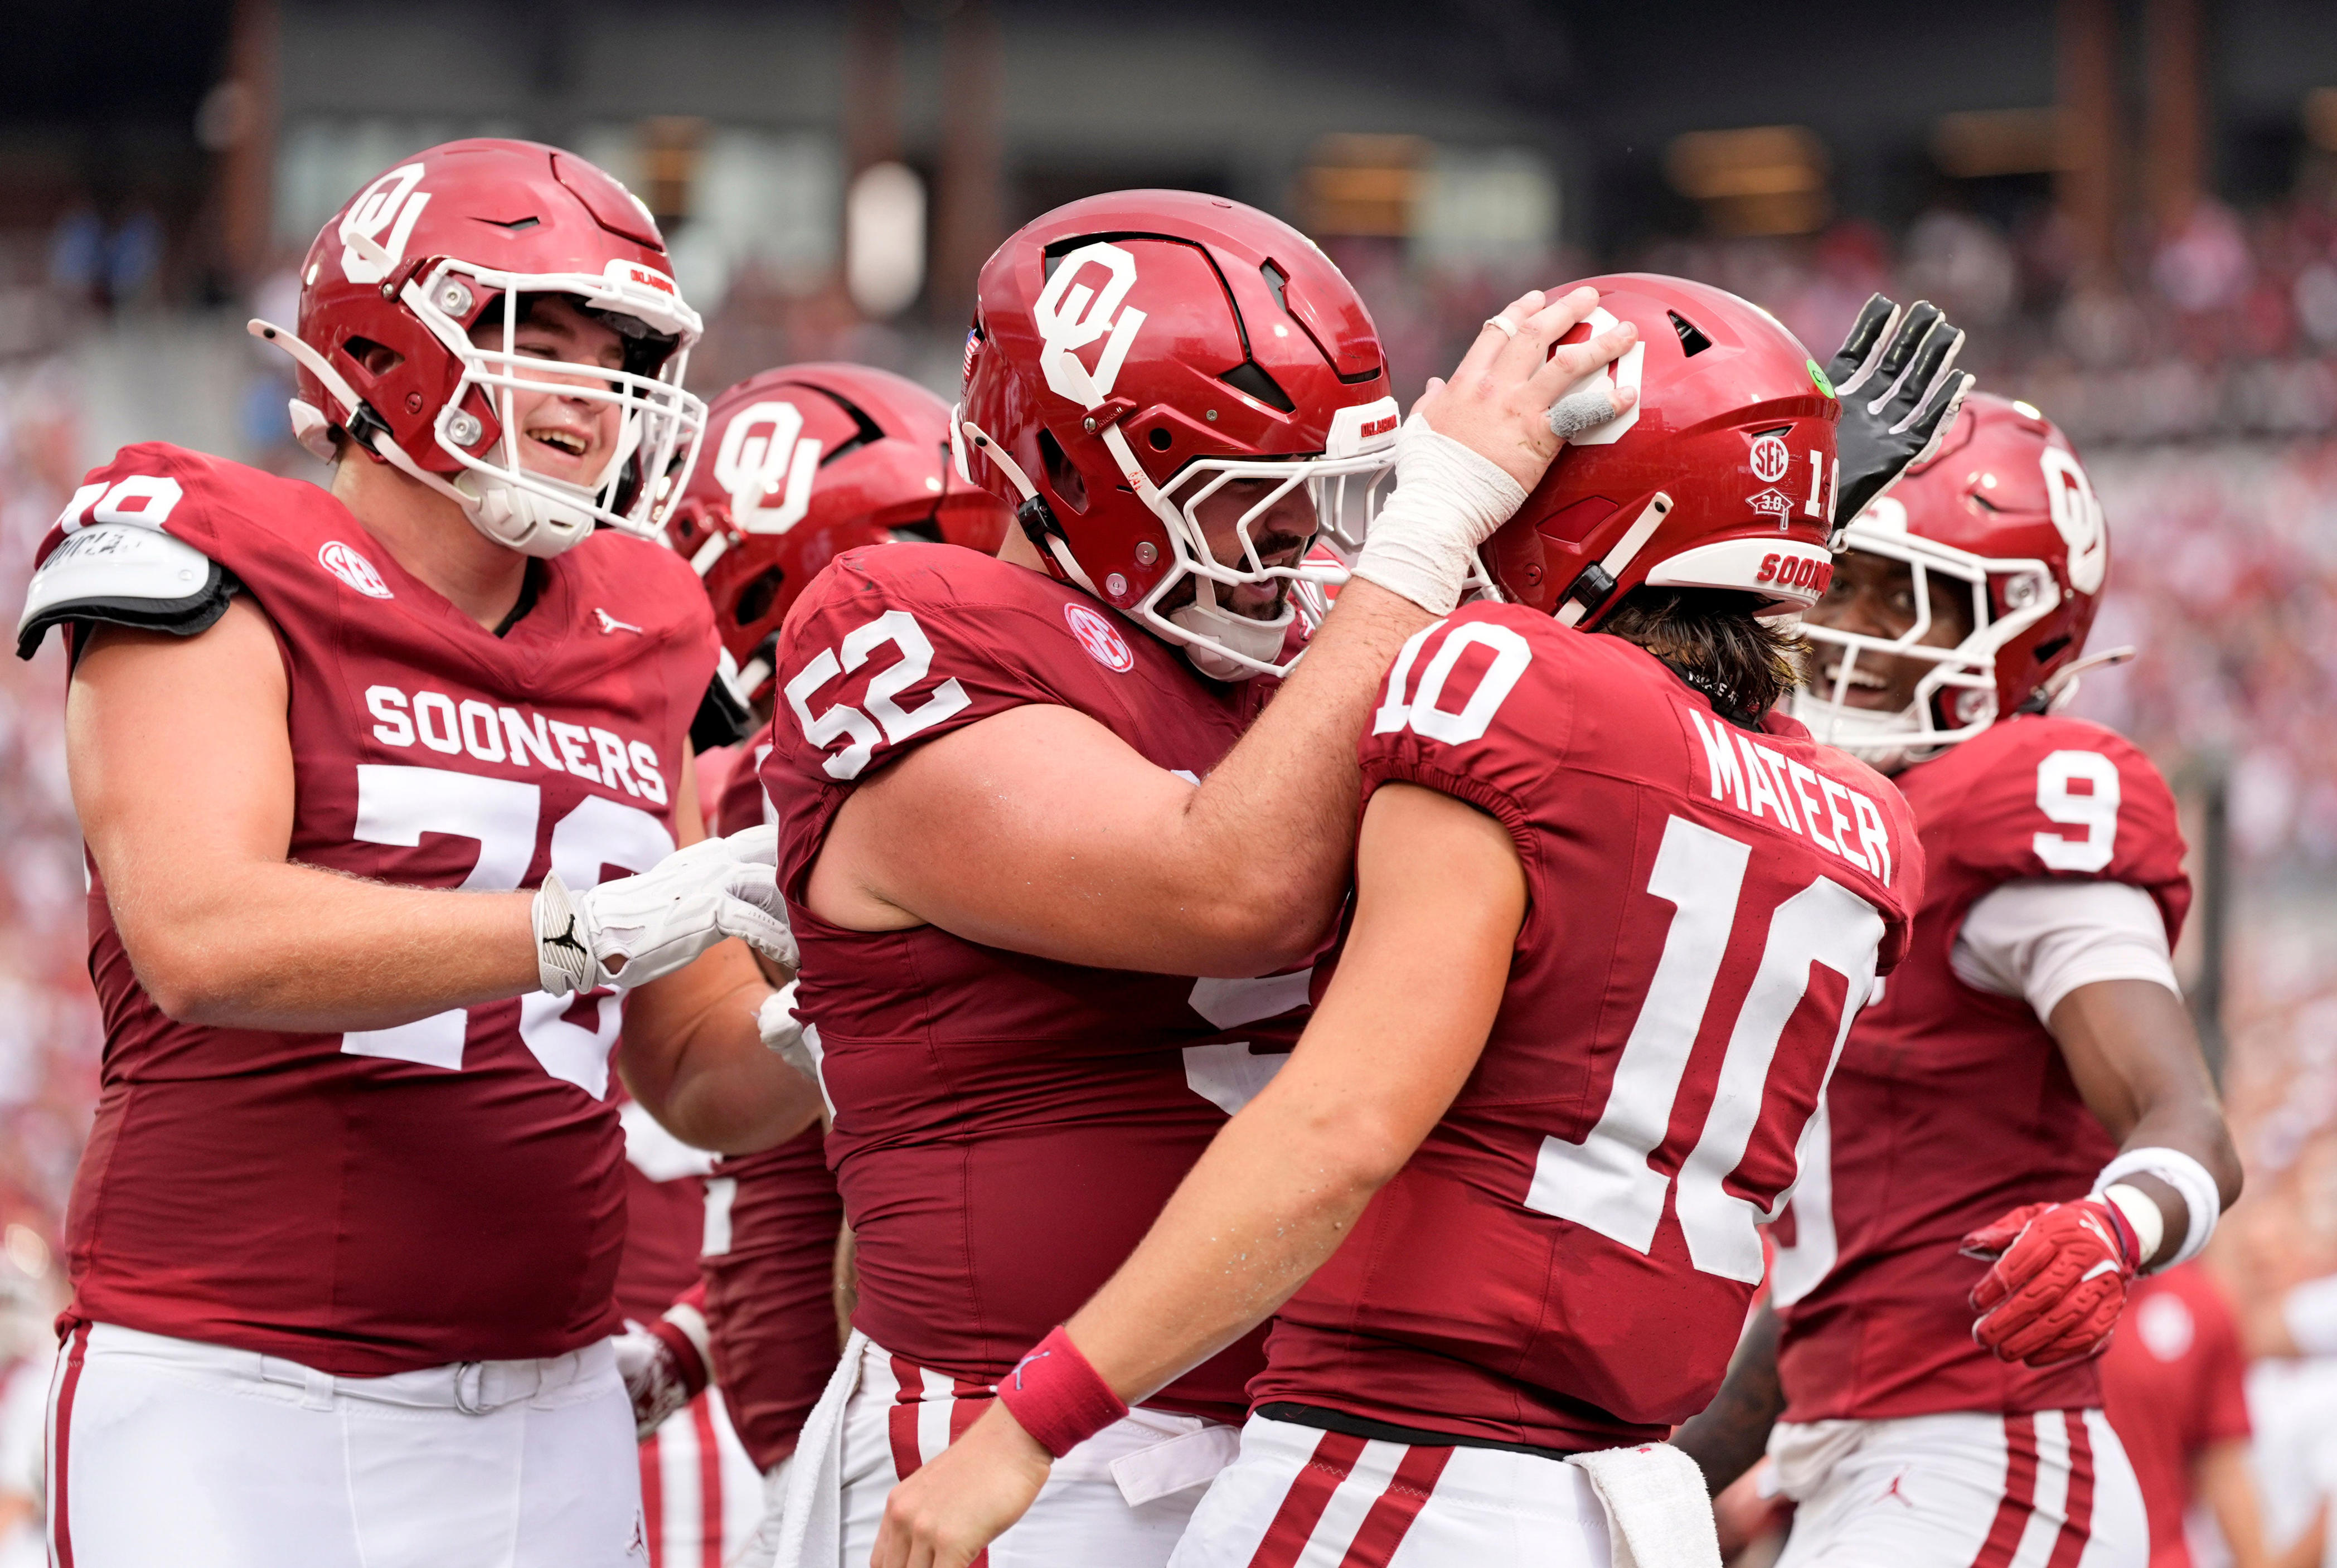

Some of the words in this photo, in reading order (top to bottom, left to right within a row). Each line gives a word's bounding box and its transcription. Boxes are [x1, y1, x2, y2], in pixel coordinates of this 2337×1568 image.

[1034, 241, 1148, 408] OU
[714, 401, 823, 535] OU
[1755, 440, 1784, 477] SEC
[1761, 494, 1782, 511] 3.0
[1804, 449, 1839, 531] 10
[784, 610, 972, 779] 52
[1070, 608, 1128, 667] SEC
[1372, 619, 1533, 746] 10
[365, 685, 668, 805] SOONERS
[1688, 707, 1891, 889] MATEER
[2033, 750, 2121, 873] 9
[1524, 814, 1885, 1287] 10
